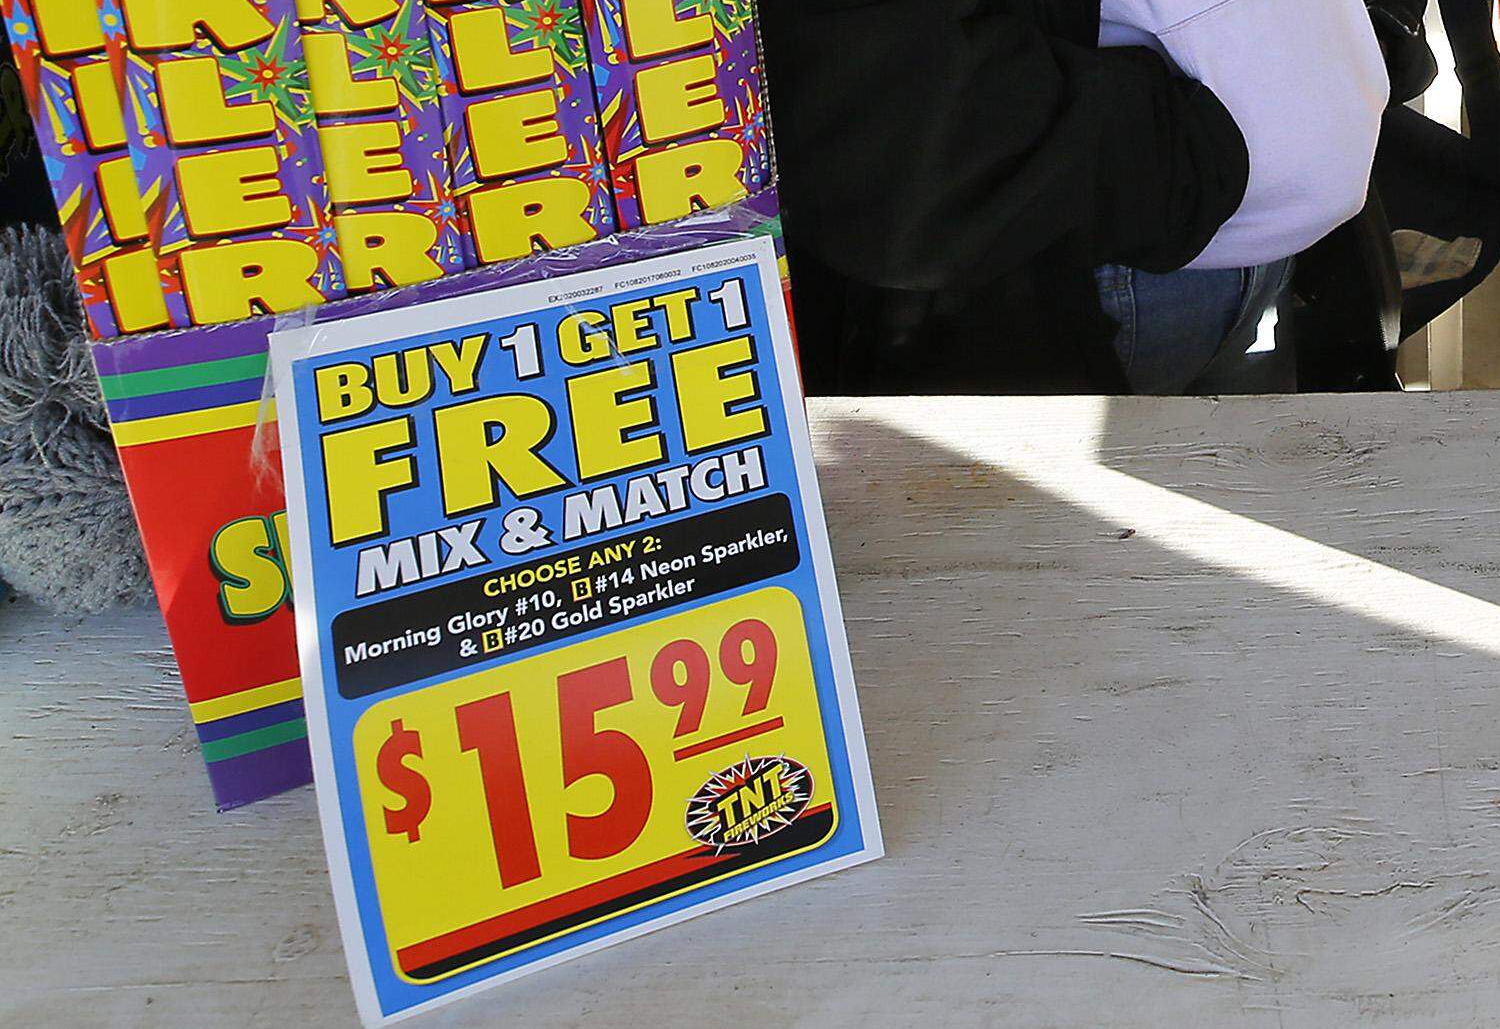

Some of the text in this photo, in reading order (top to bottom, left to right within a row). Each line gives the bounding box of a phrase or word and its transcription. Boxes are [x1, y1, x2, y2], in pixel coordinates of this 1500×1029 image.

[314, 278, 749, 425] BUY 1 GET 1
[320, 334, 771, 550] FREE
[356, 447, 766, 597] MIX & MATCH
[483, 535, 663, 598] CHOOSE ANY 2:
[344, 527, 789, 665] Morning Glory #10, #14 Neon Sparkler,
[459, 638, 478, 658] &
[550, 602, 604, 628] Gold
[608, 576, 695, 617] Sparkler
[722, 791, 795, 843] FIREWORKS
